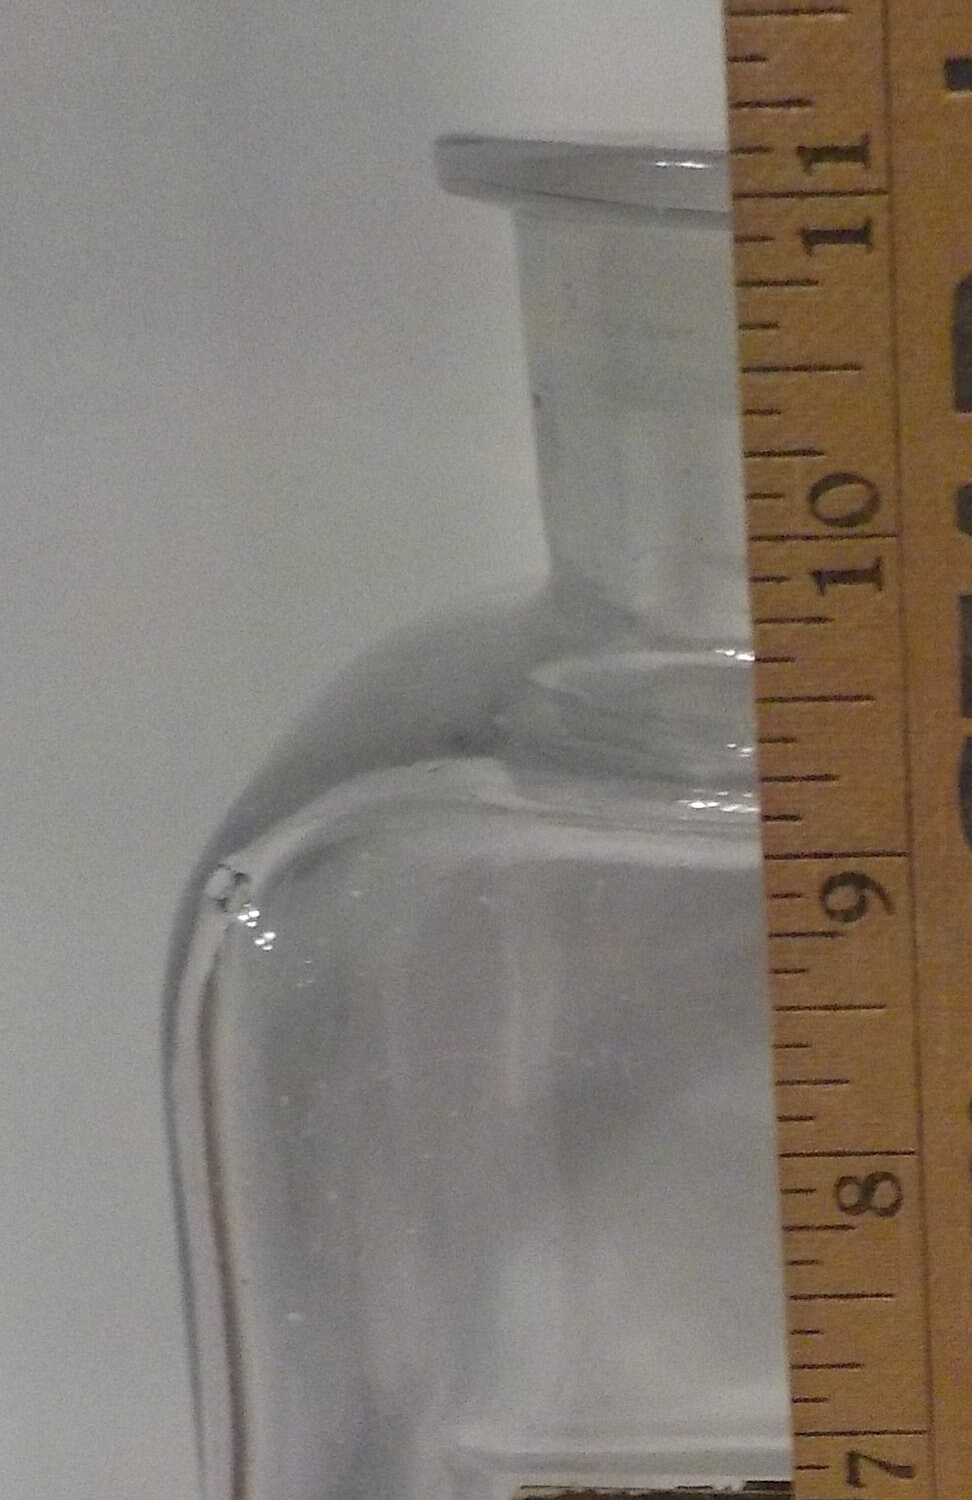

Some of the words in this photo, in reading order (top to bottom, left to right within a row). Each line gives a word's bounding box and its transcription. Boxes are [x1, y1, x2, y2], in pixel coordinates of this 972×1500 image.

[796, 133, 875, 256] 11
[808, 473, 884, 596] 10
[818, 871, 895, 923] 9
[833, 1170, 904, 1220] 8
[844, 1449, 916, 1487] 7
